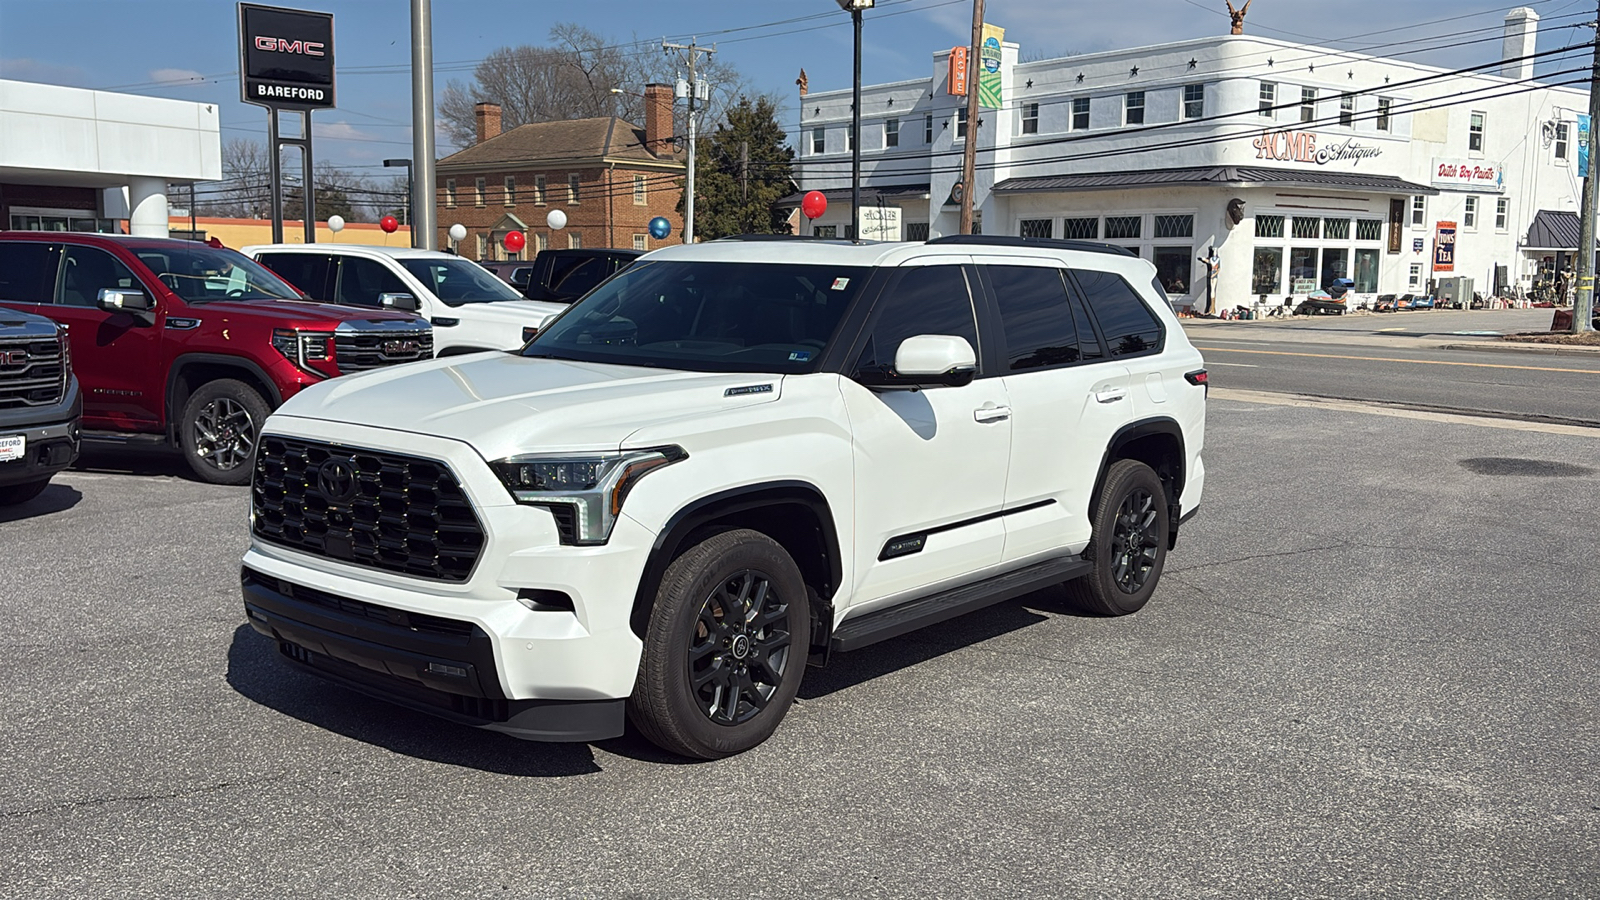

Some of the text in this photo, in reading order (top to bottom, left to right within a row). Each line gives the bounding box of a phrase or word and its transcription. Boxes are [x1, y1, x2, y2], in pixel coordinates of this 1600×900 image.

[255, 36, 325, 56] GMC
[258, 84, 324, 100] BAREFORD
[1253, 130, 1316, 163] ACME
[1328, 137, 1383, 167] Antiques
[1438, 163, 1495, 182] Dutch Boy Paints
[1438, 249, 1452, 262] TEA
